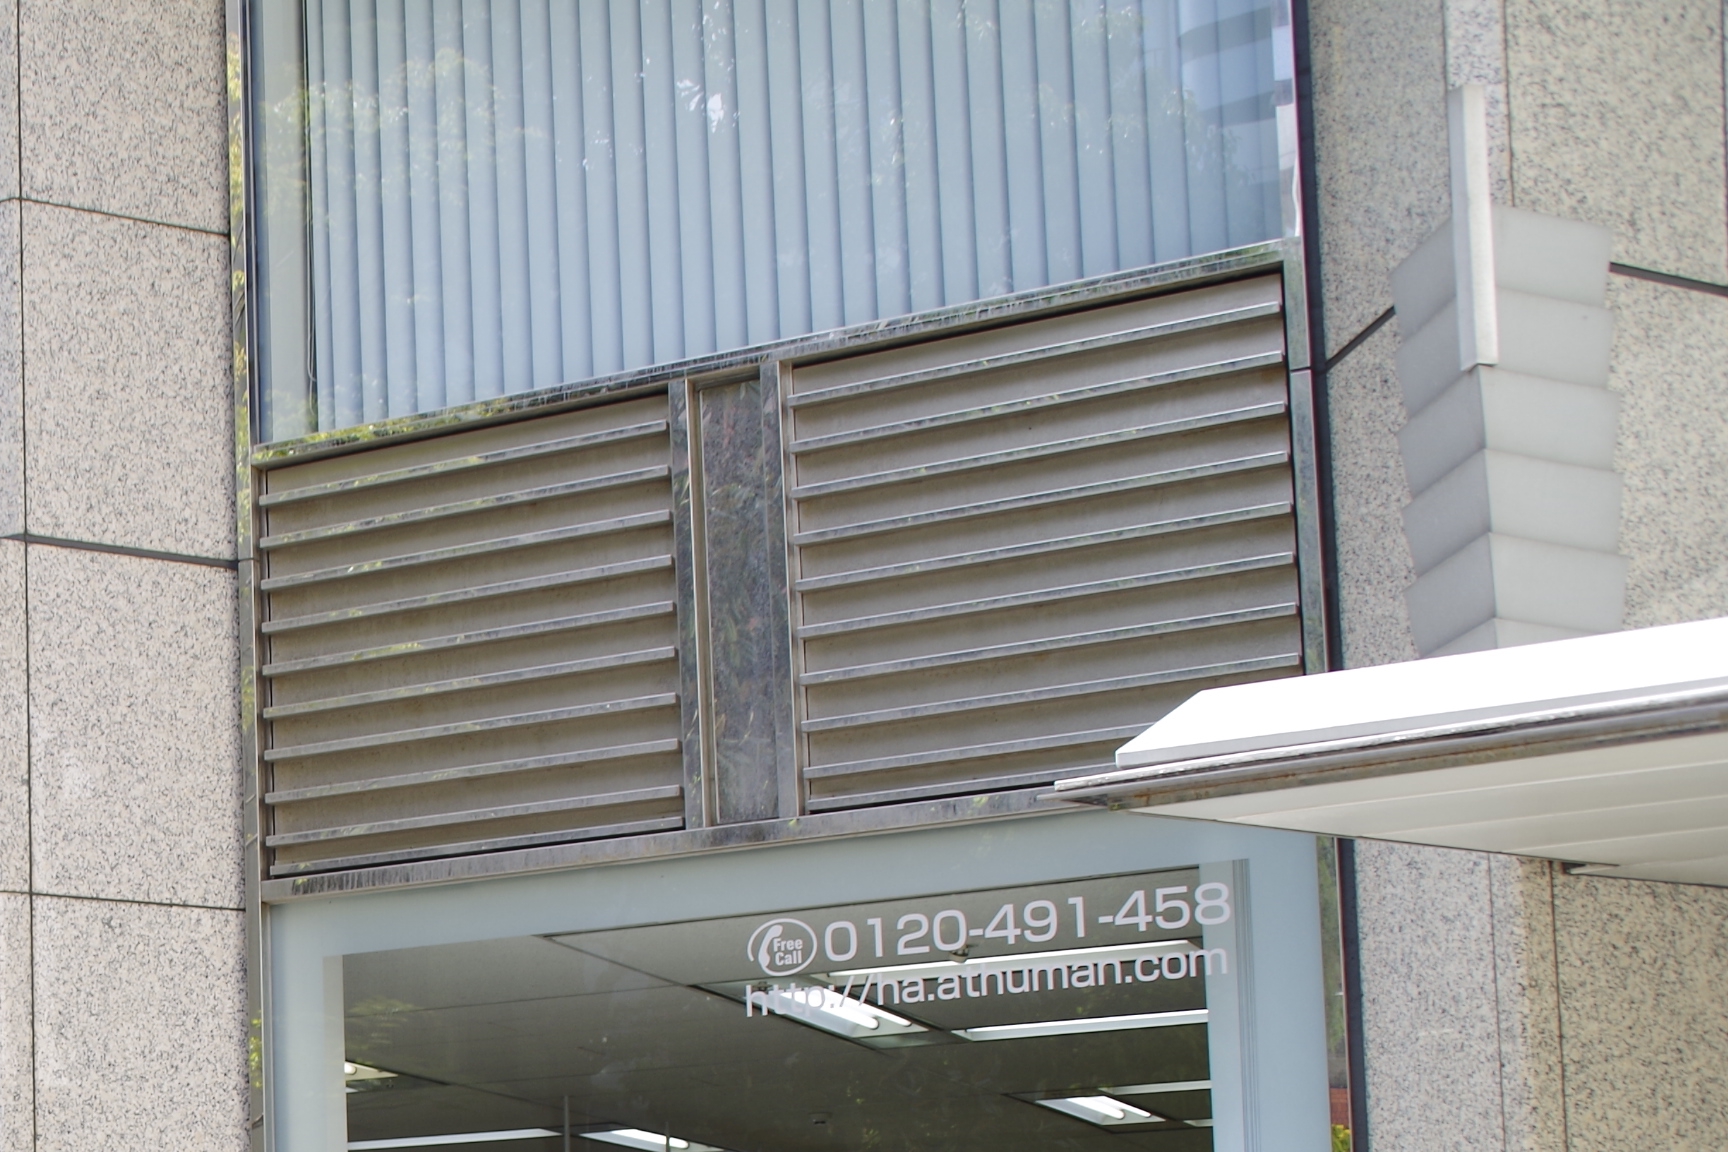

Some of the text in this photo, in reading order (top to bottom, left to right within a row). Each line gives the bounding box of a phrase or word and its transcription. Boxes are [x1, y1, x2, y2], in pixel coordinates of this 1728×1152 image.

[823, 881, 1232, 963] 0120-491-458
[773, 937, 804, 952] Free
[774, 950, 803, 966] Call
[745, 946, 1229, 1018] http://ha.athuman.com
